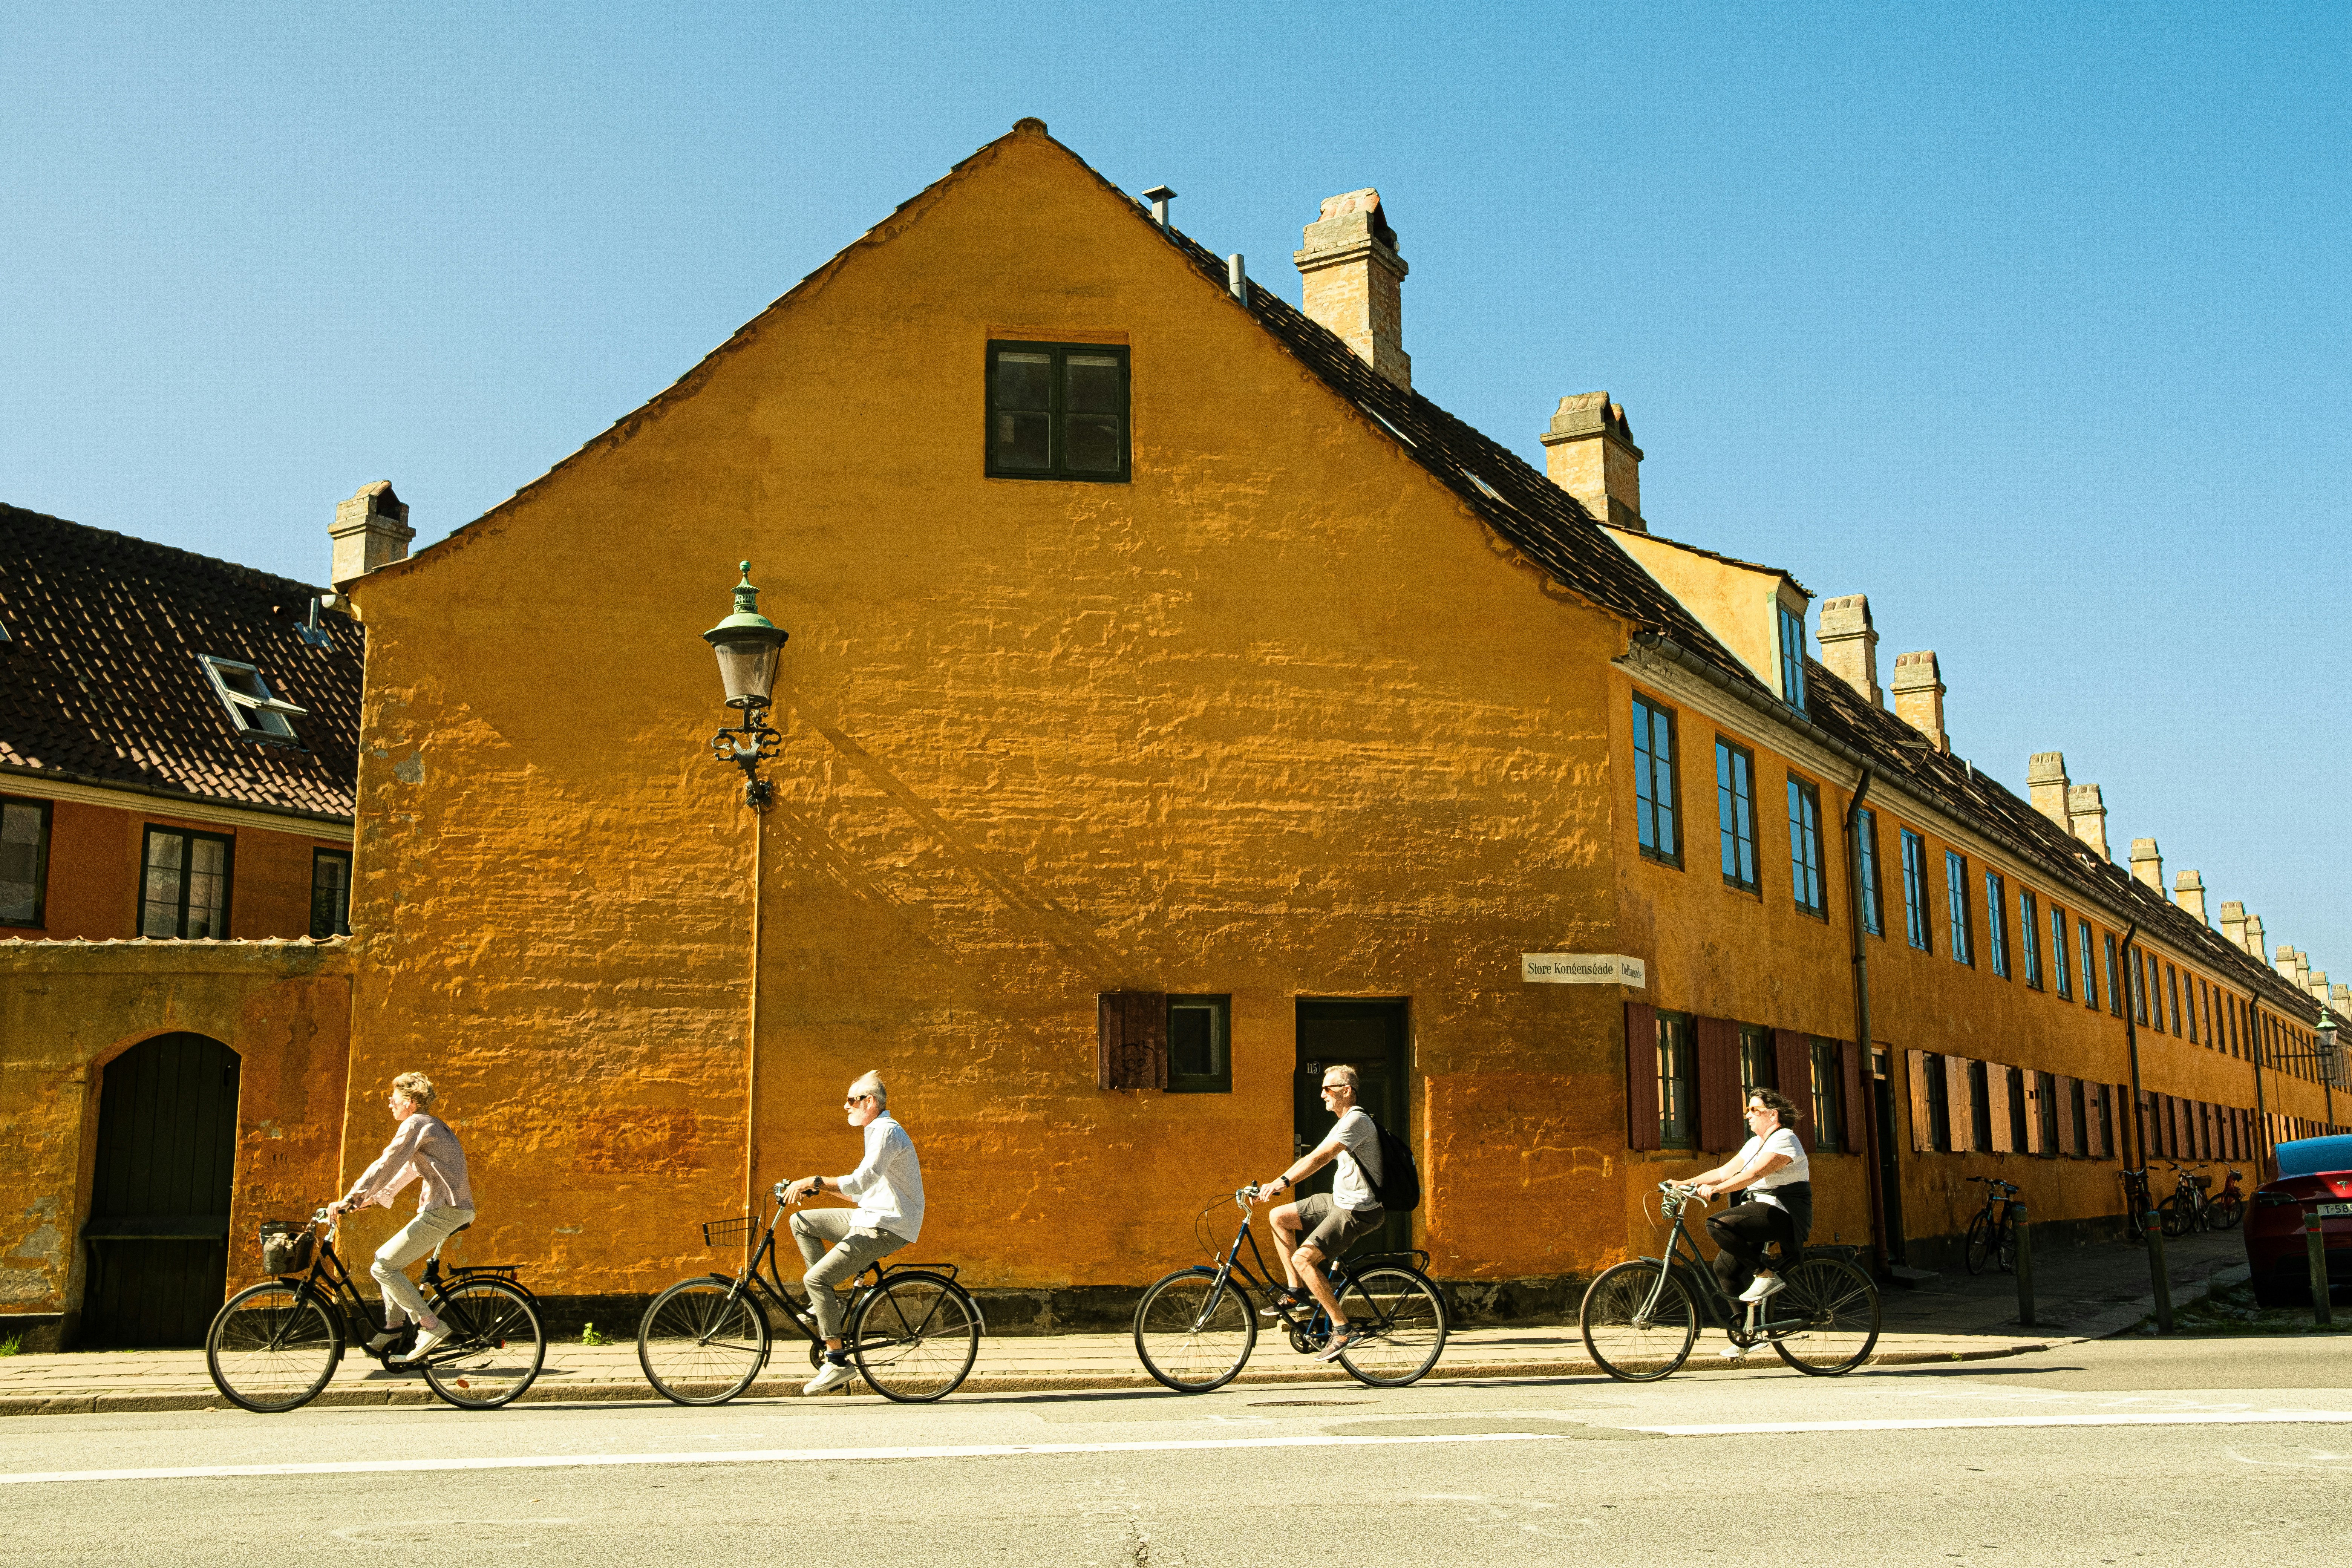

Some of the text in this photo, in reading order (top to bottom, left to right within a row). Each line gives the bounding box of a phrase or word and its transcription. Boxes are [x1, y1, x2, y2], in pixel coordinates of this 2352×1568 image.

[1528, 962, 1613, 975] Store Kongensgade
[1622, 963, 1642, 979] Delfingade
[1307, 1063, 1317, 1073] 115
